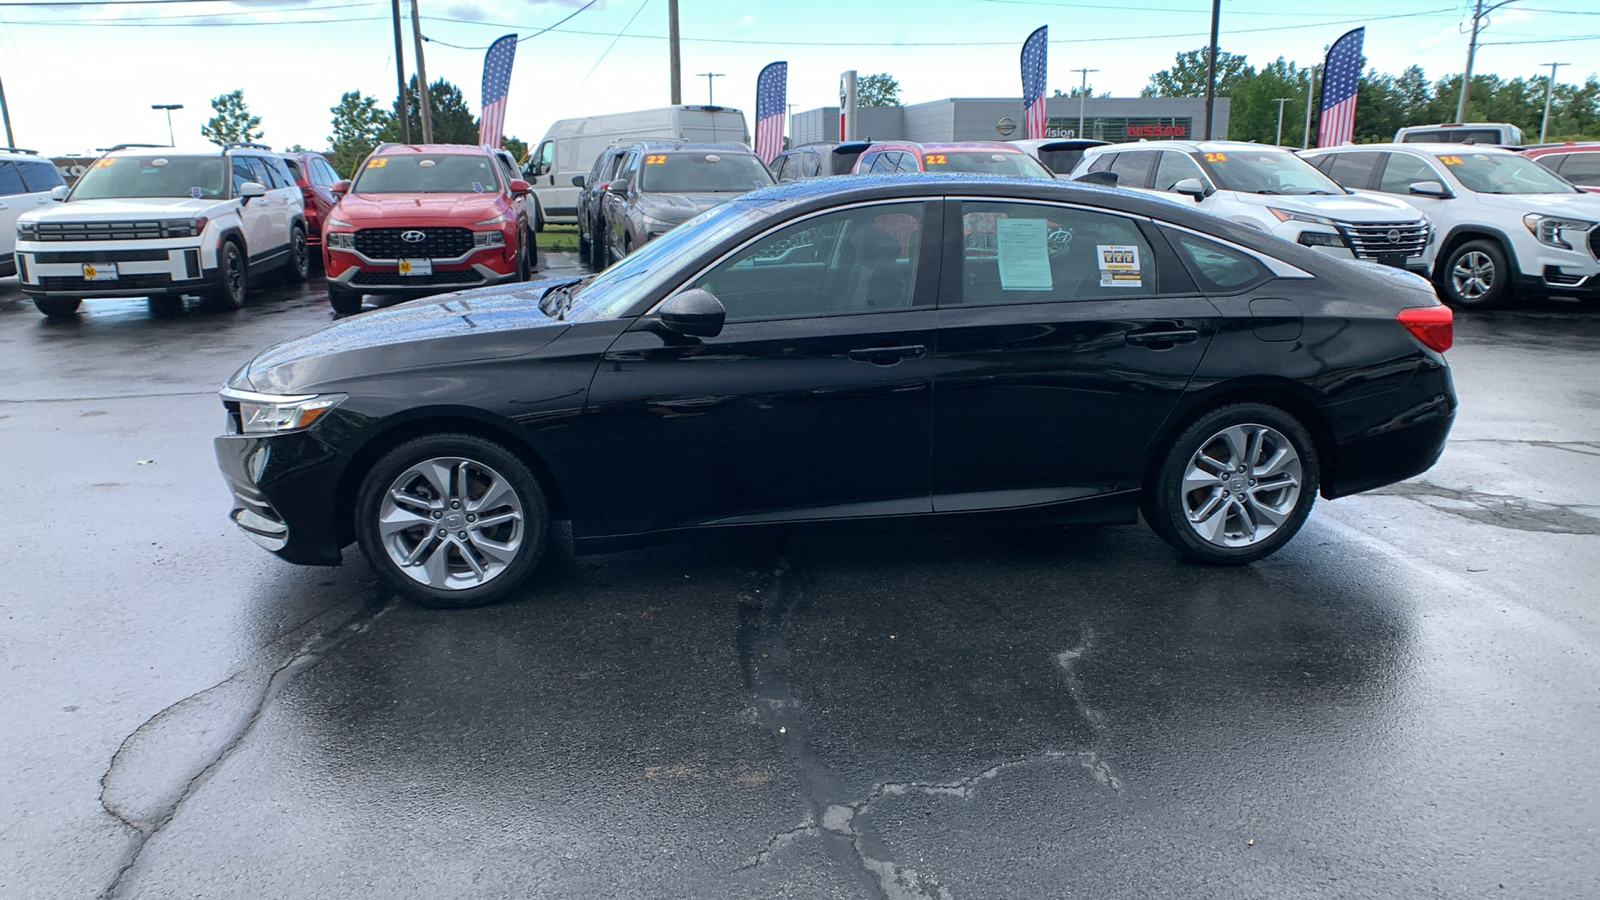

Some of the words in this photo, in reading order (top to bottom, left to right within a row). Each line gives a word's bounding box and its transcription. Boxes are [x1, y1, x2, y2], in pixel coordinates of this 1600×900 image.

[1127, 125, 1185, 136] NISSAN
[646, 155, 667, 164] 22
[925, 155, 946, 164] 22
[1204, 152, 1227, 162] 24
[1440, 155, 1463, 165] 24
[367, 158, 388, 168] 23
